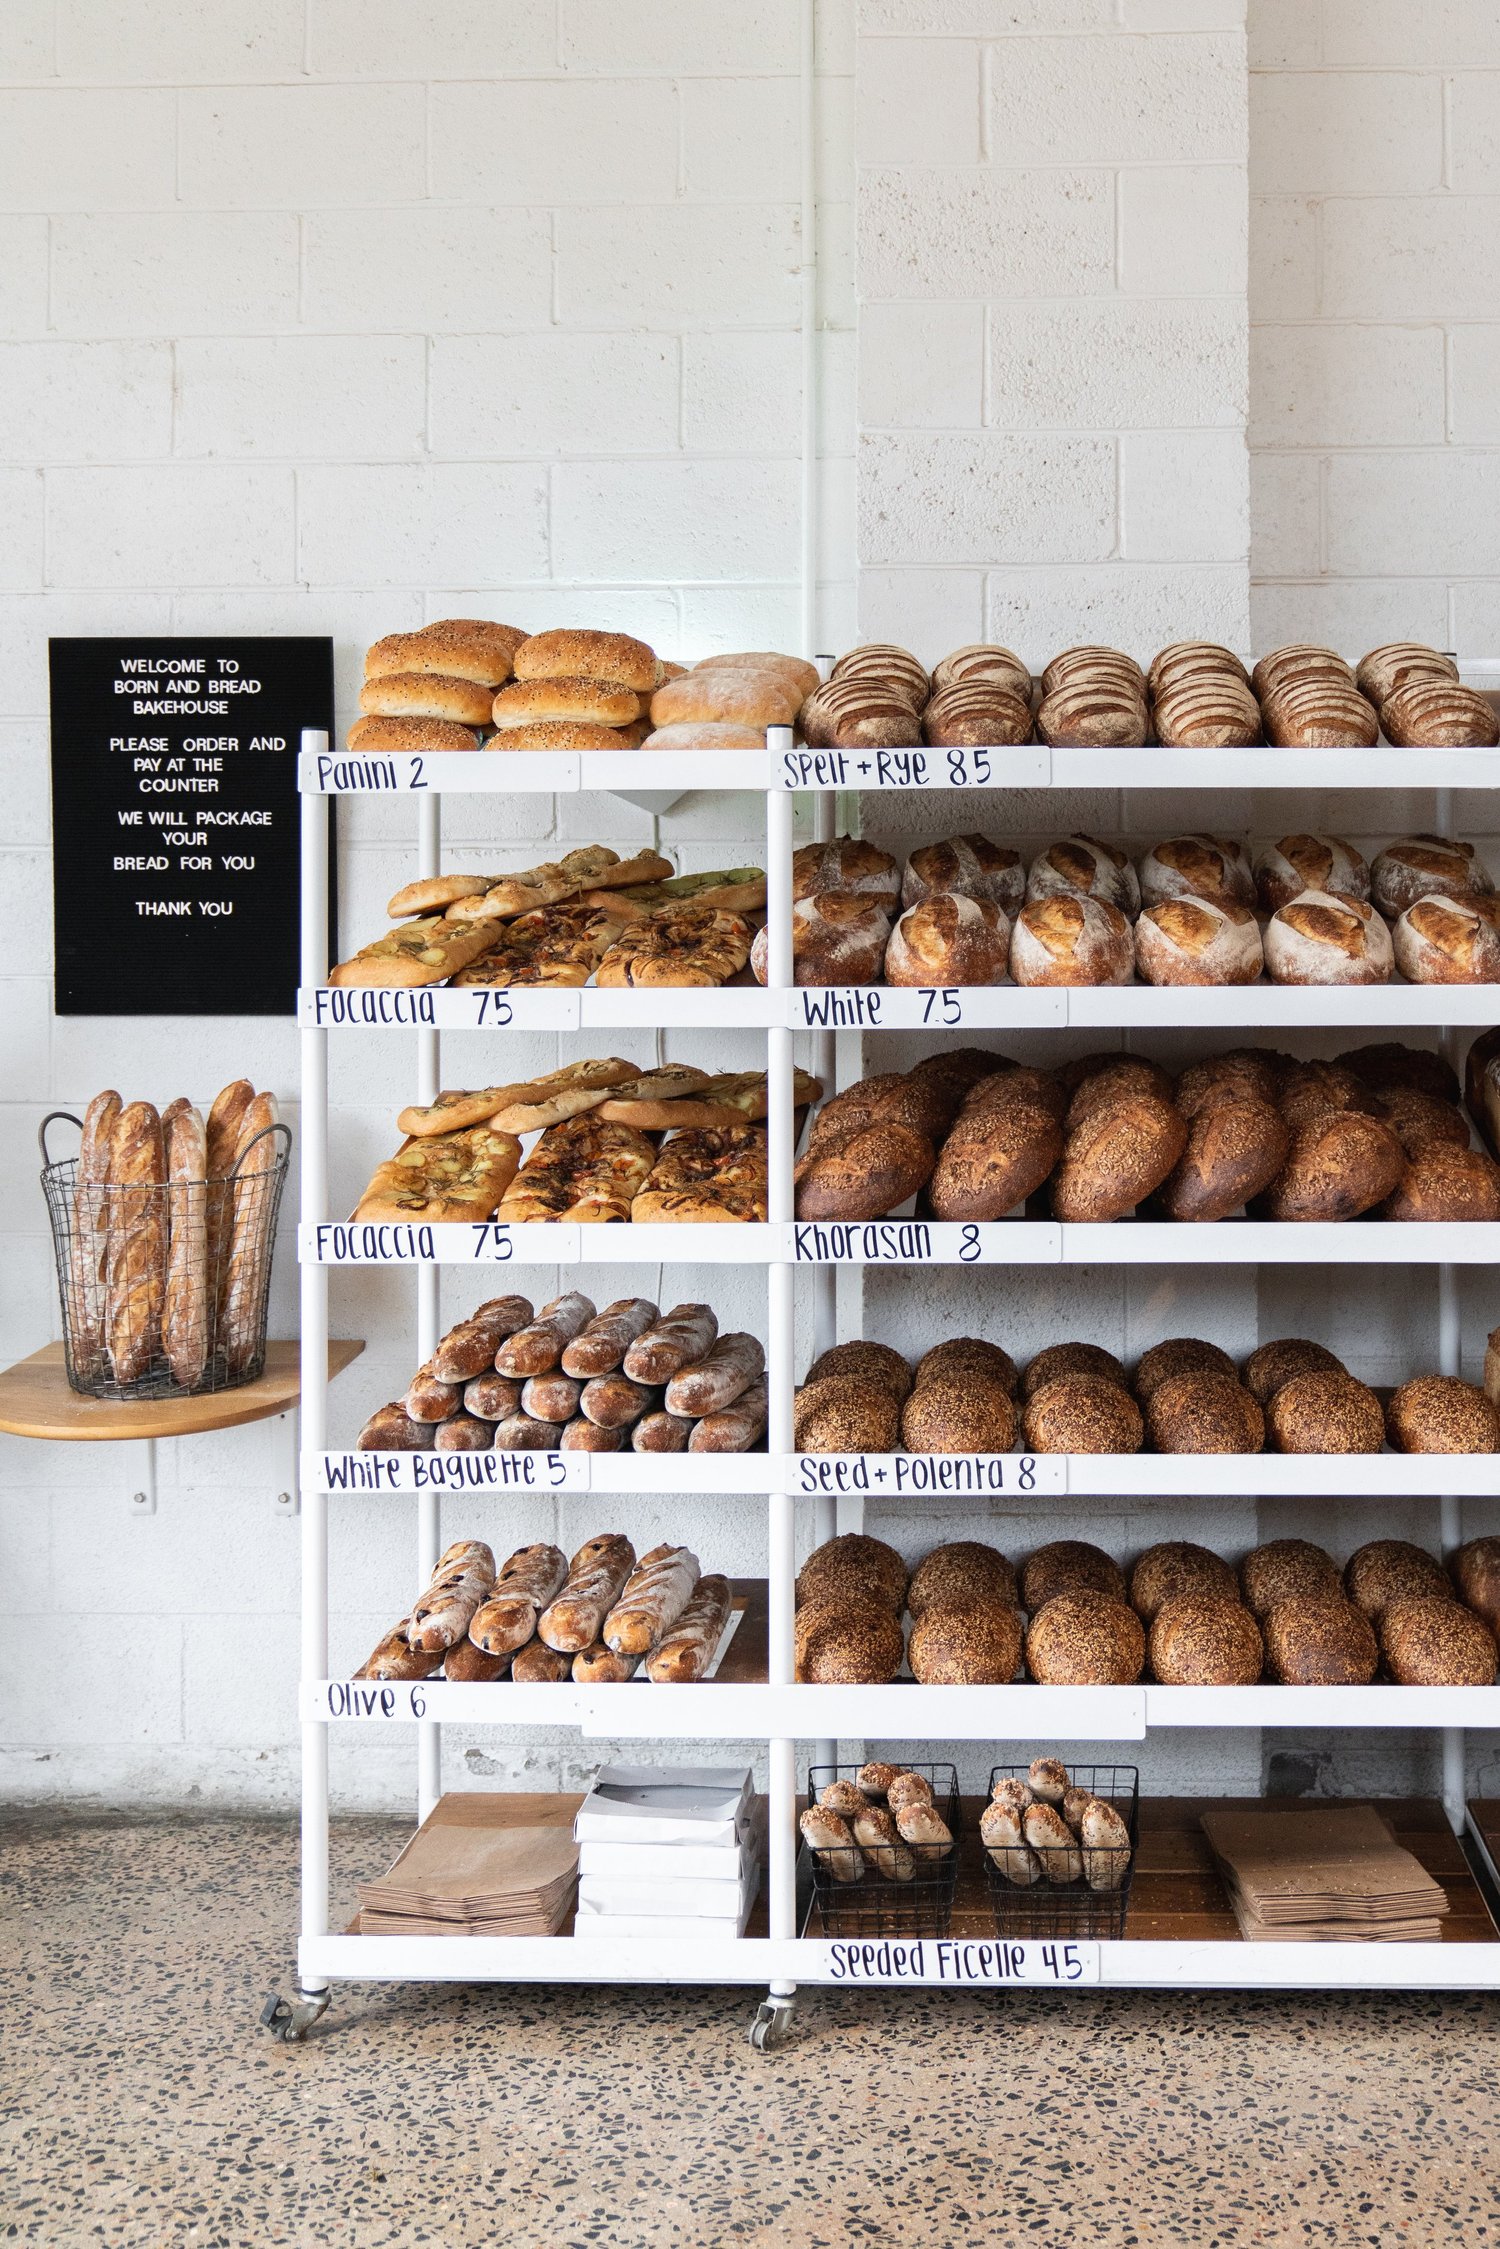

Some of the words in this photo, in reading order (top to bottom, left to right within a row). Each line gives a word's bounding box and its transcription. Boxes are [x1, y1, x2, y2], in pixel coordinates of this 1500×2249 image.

[121, 659, 206, 673] WELCOME
[217, 659, 239, 673] TO
[114, 680, 158, 694] BORN
[166, 680, 200, 694] AND
[208, 680, 261, 694] BREAD
[133, 700, 229, 715] BAKEHOUSE
[110, 738, 169, 751] PLEASE
[183, 737, 239, 751] ORDER
[249, 737, 286, 751] AND
[133, 757, 161, 772] PAY
[166, 758, 186, 772] AT
[193, 758, 223, 772] THE
[317, 754, 397, 791] Panini
[410, 756, 428, 789] 2
[946, 749, 991, 786] 8.5
[139, 777, 219, 793] COUNTER
[118, 811, 143, 825] WE
[148, 811, 188, 825] WILL
[196, 811, 272, 825] PACKAGE
[162, 832, 207, 846] YOUR
[113, 856, 169, 870] BREAD
[180, 856, 212, 870] FOR
[221, 856, 255, 870] YOU
[135, 902, 191, 915] THANK
[199, 901, 233, 916] YOU
[315, 989, 436, 1025] Focaccia
[803, 989, 883, 1026] White
[316, 1224, 436, 1261] Focaccia
[794, 1224, 932, 1261] Khorasan
[959, 1223, 982, 1262] 8
[324, 1453, 401, 1489] White
[412, 1453, 535, 1490] Baguette
[547, 1453, 567, 1486] 5
[1018, 1456, 1037, 1490] 8
[327, 1682, 395, 1718] Olive
[410, 1685, 426, 1718] 6
[830, 1941, 925, 1979] Seeded
[937, 1942, 1026, 1979] Ficelle
